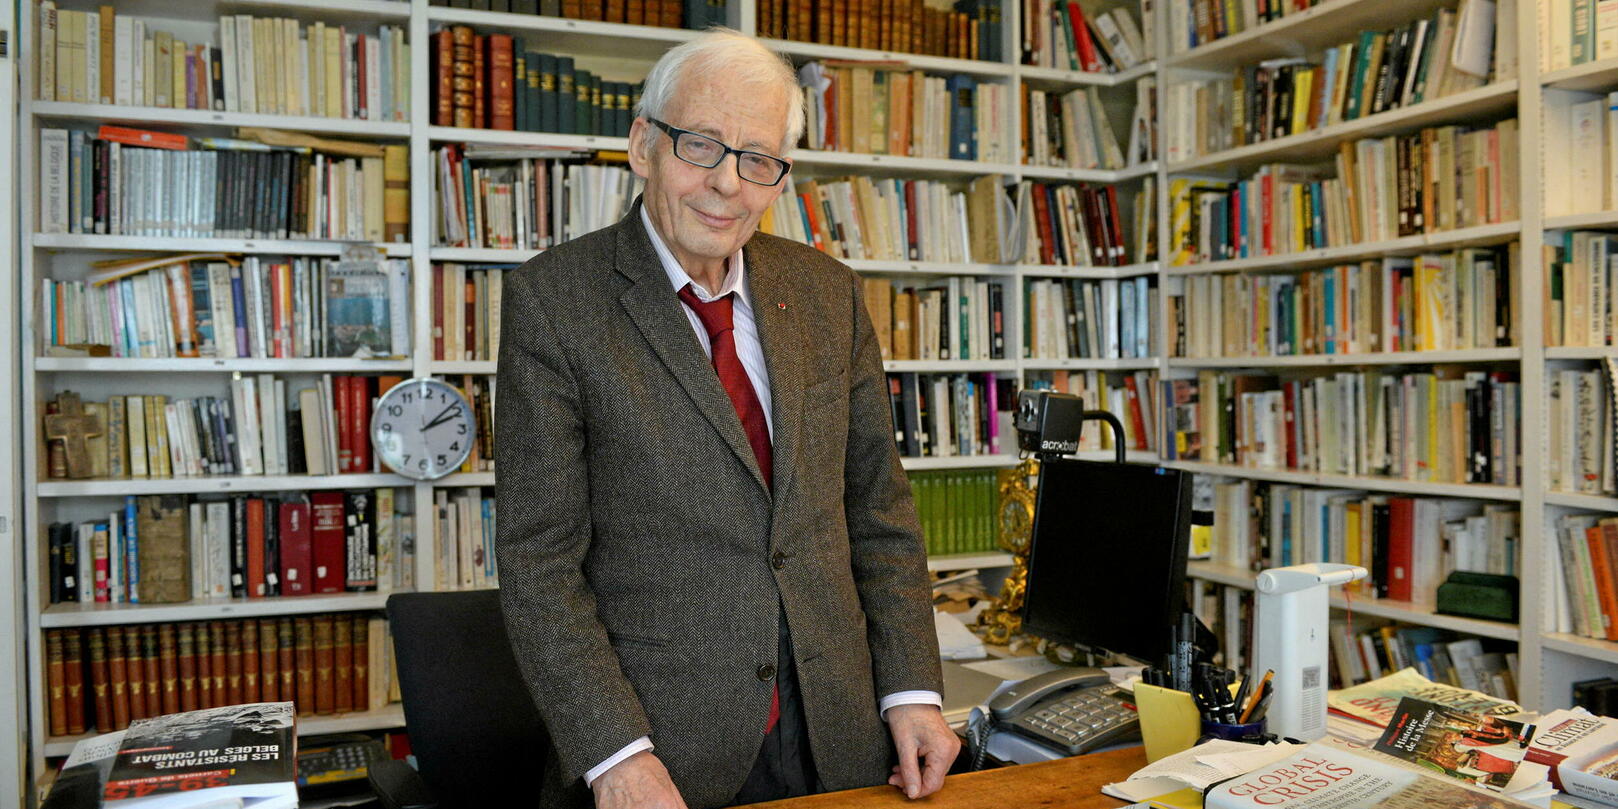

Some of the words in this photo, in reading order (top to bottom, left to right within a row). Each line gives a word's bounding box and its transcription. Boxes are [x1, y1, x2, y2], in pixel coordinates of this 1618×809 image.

[402, 393, 413, 404] 11
[441, 394, 446, 404] 1
[388, 405, 403, 417] 10
[453, 406, 462, 417] 2
[382, 423, 392, 433] 9
[457, 424, 467, 435] 3
[449, 441, 460, 452] 4
[403, 455, 411, 466] 7
[418, 458, 429, 471] 6
[437, 455, 447, 466] 5
[1416, 709, 1435, 733] Messe
[1394, 719, 1418, 749] Histoire
[1413, 733, 1421, 744] la
[1535, 718, 1600, 748] Climat
[224, 744, 279, 755] BELGES
[1405, 742, 1417, 752] de
[132, 751, 195, 765] COMBAT
[198, 749, 220, 758] AU
[251, 752, 279, 762] LES
[1228, 757, 1328, 797] GLOBAL
[1253, 762, 1354, 806] CRISIS
